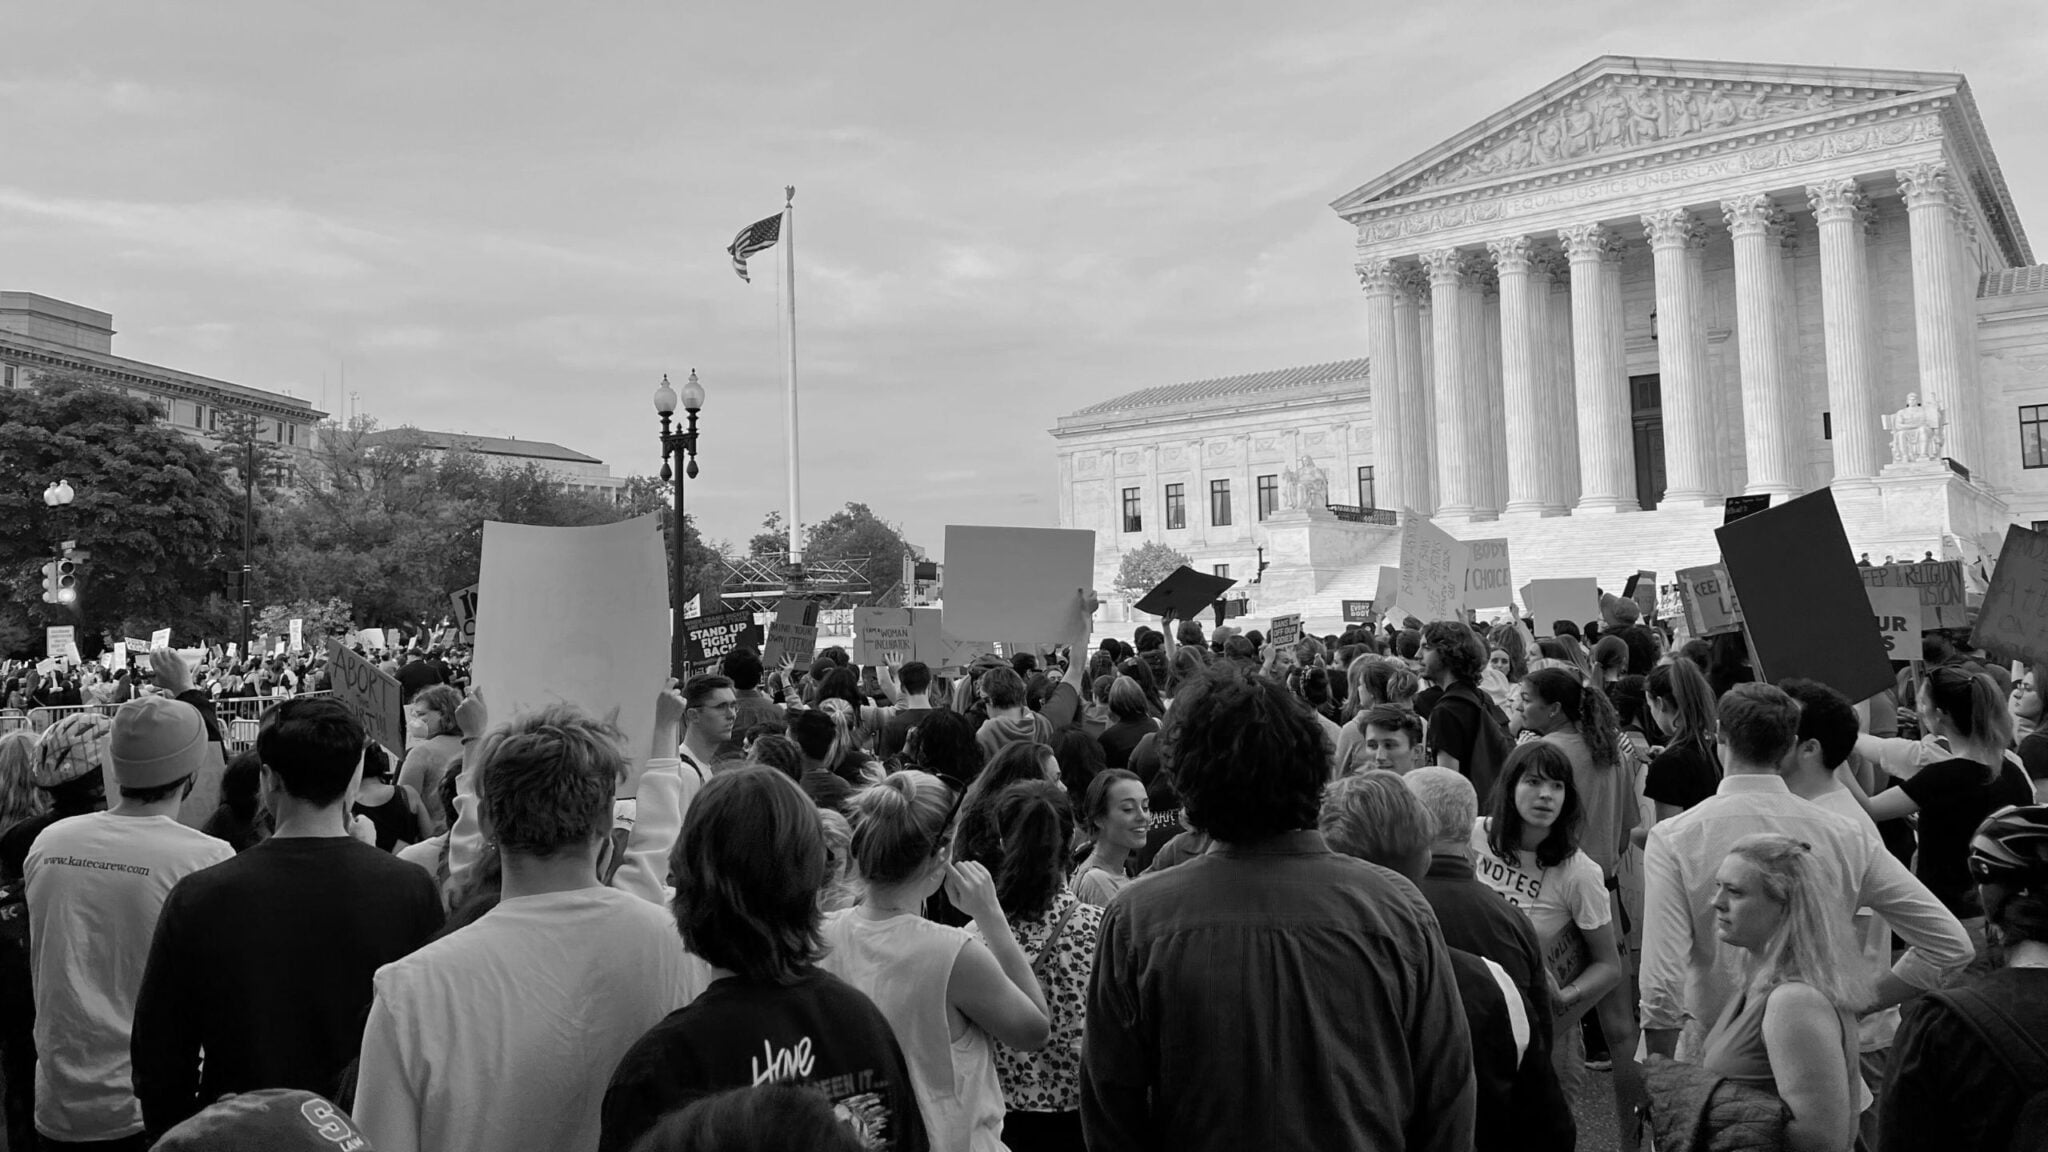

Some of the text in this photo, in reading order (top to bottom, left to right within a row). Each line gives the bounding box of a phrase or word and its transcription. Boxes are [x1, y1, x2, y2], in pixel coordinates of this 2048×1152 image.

[1514, 160, 1730, 211] EQUAL JUSTICE UNDER LAW
[1472, 542, 1507, 562] BODY
[1472, 568, 1509, 591] CHOICE
[1692, 579, 1721, 597] KEE
[689, 622, 747, 641] STAND UP
[701, 633, 737, 649] FIGHT
[881, 628, 908, 638] WOMAN
[333, 650, 395, 712] ABORT
[44, 856, 150, 876] www.katecarew.com
[1483, 857, 1541, 898] VOTES
[301, 1098, 351, 1142] S
